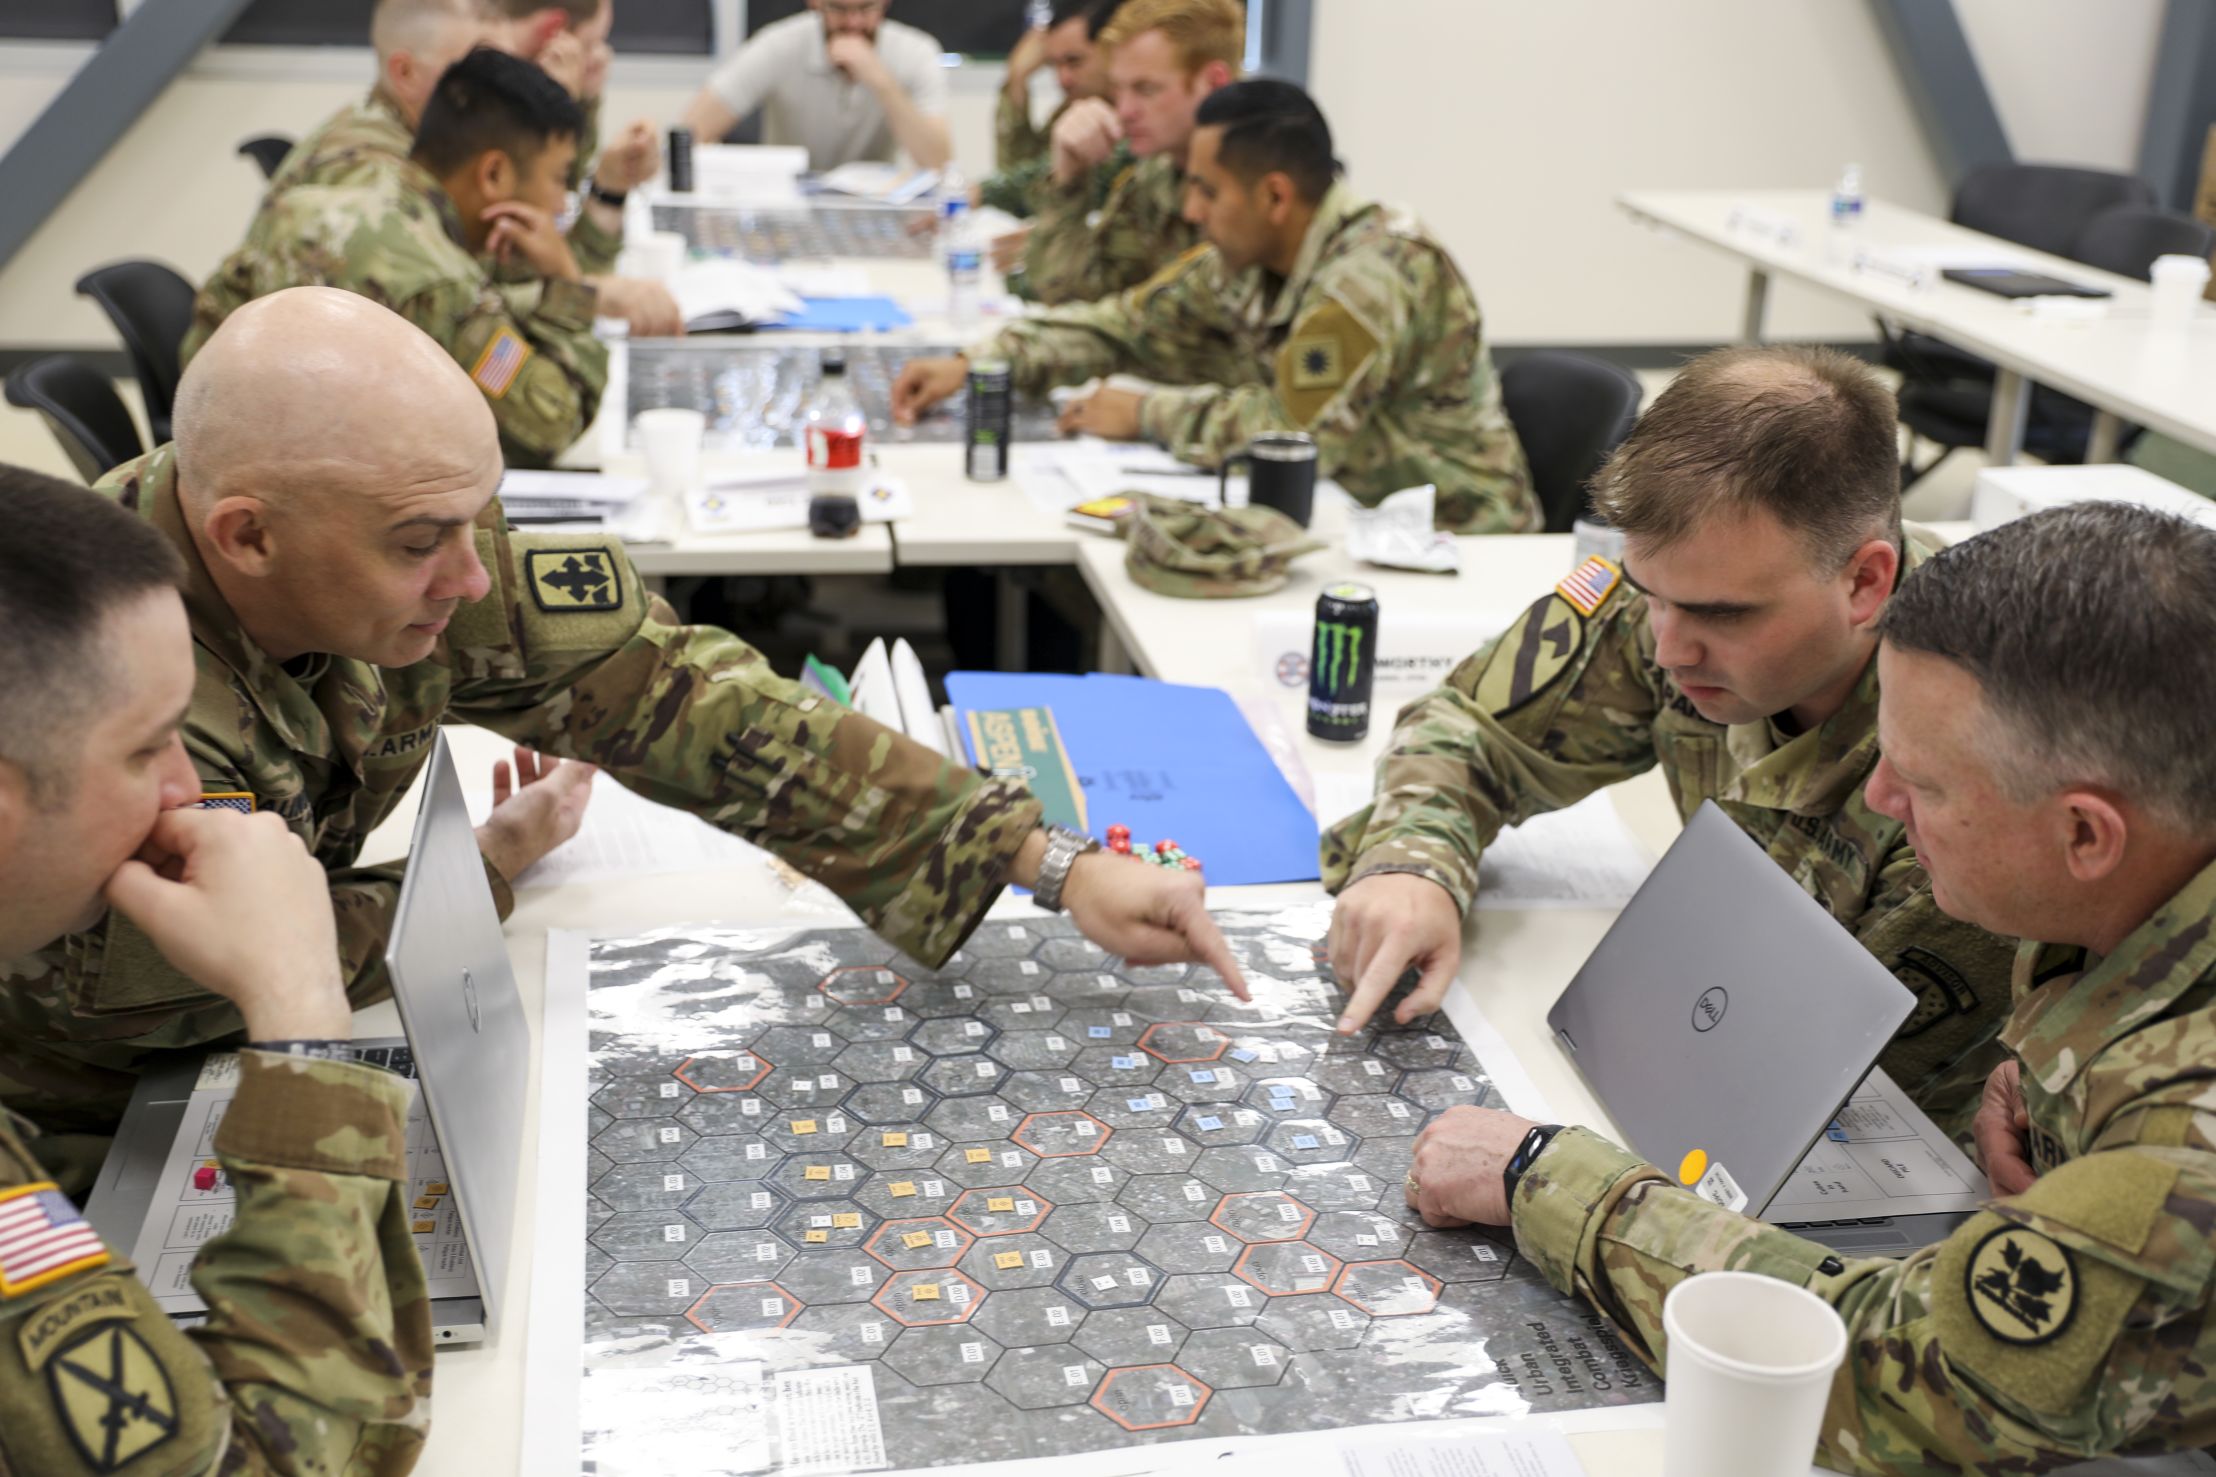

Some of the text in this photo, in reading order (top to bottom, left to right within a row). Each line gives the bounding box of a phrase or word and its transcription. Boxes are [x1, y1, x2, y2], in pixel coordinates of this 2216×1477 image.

[381, 722, 436, 756] ARM
[1922, 956, 1966, 996] ADVISOR
[1699, 996, 1720, 1022] DELL
[28, 1289, 125, 1349] MOUNTAIN
[1495, 1358, 1521, 1386] uick
[1526, 1322, 1584, 1394] Integrated
[1567, 1336, 1611, 1391] Combat
[1579, 1314, 1642, 1388] Kriegsspiel
[1520, 1352, 1553, 1396] Urban
